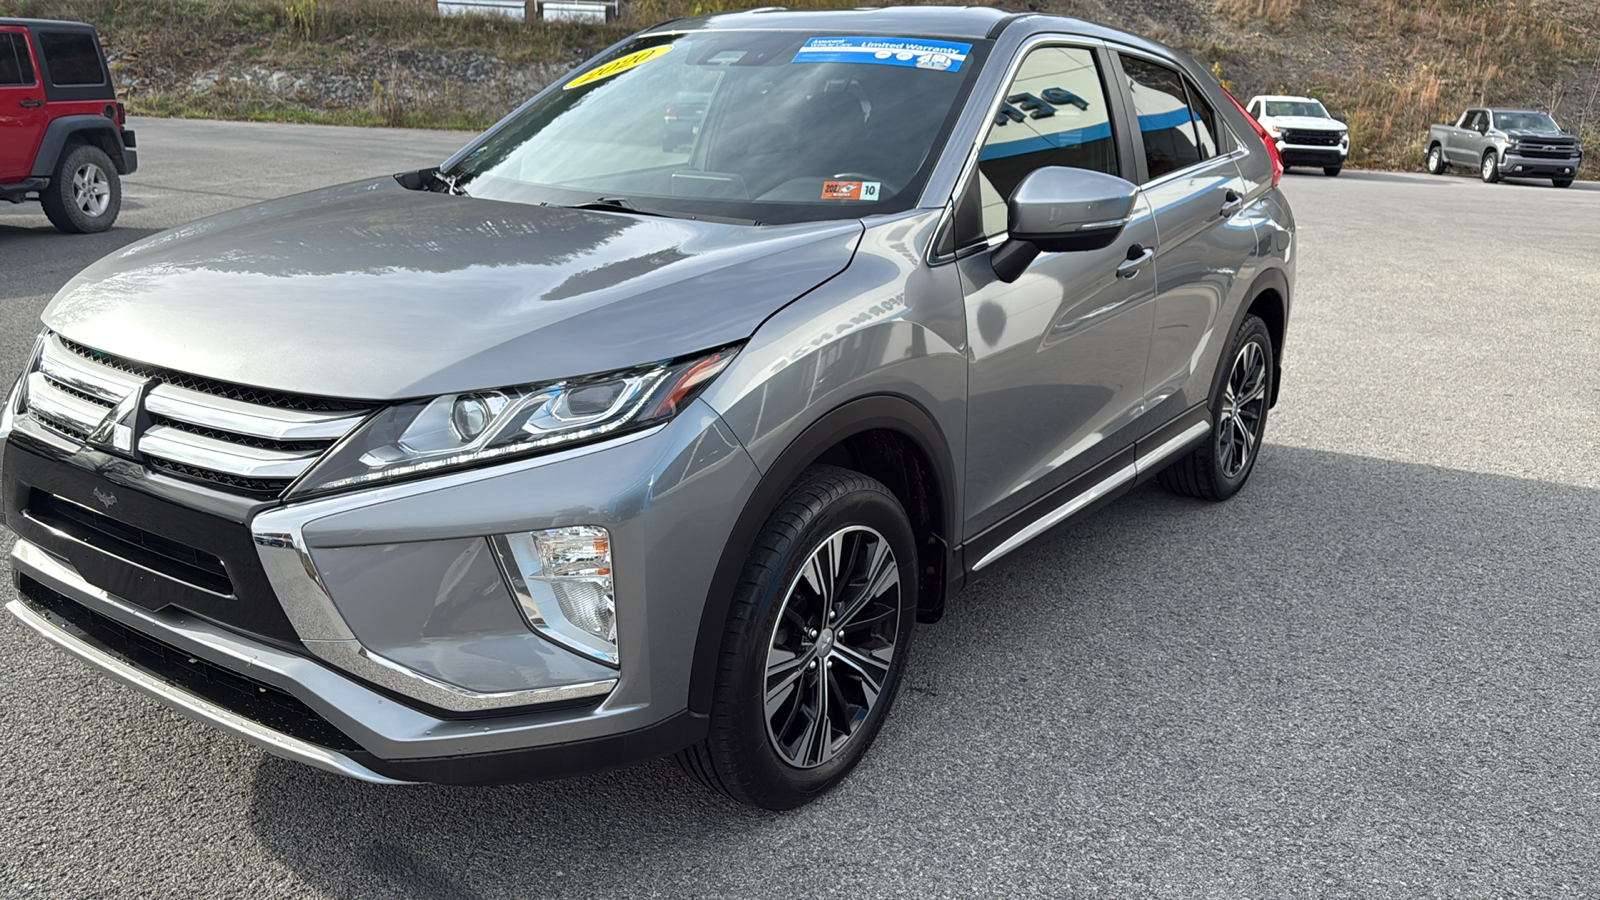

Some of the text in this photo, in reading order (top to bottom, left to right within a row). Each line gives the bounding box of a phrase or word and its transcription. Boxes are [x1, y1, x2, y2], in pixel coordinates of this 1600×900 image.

[861, 41, 960, 54] Limited Warranty
[579, 49, 656, 84] 2020
[865, 185, 876, 196] 10
